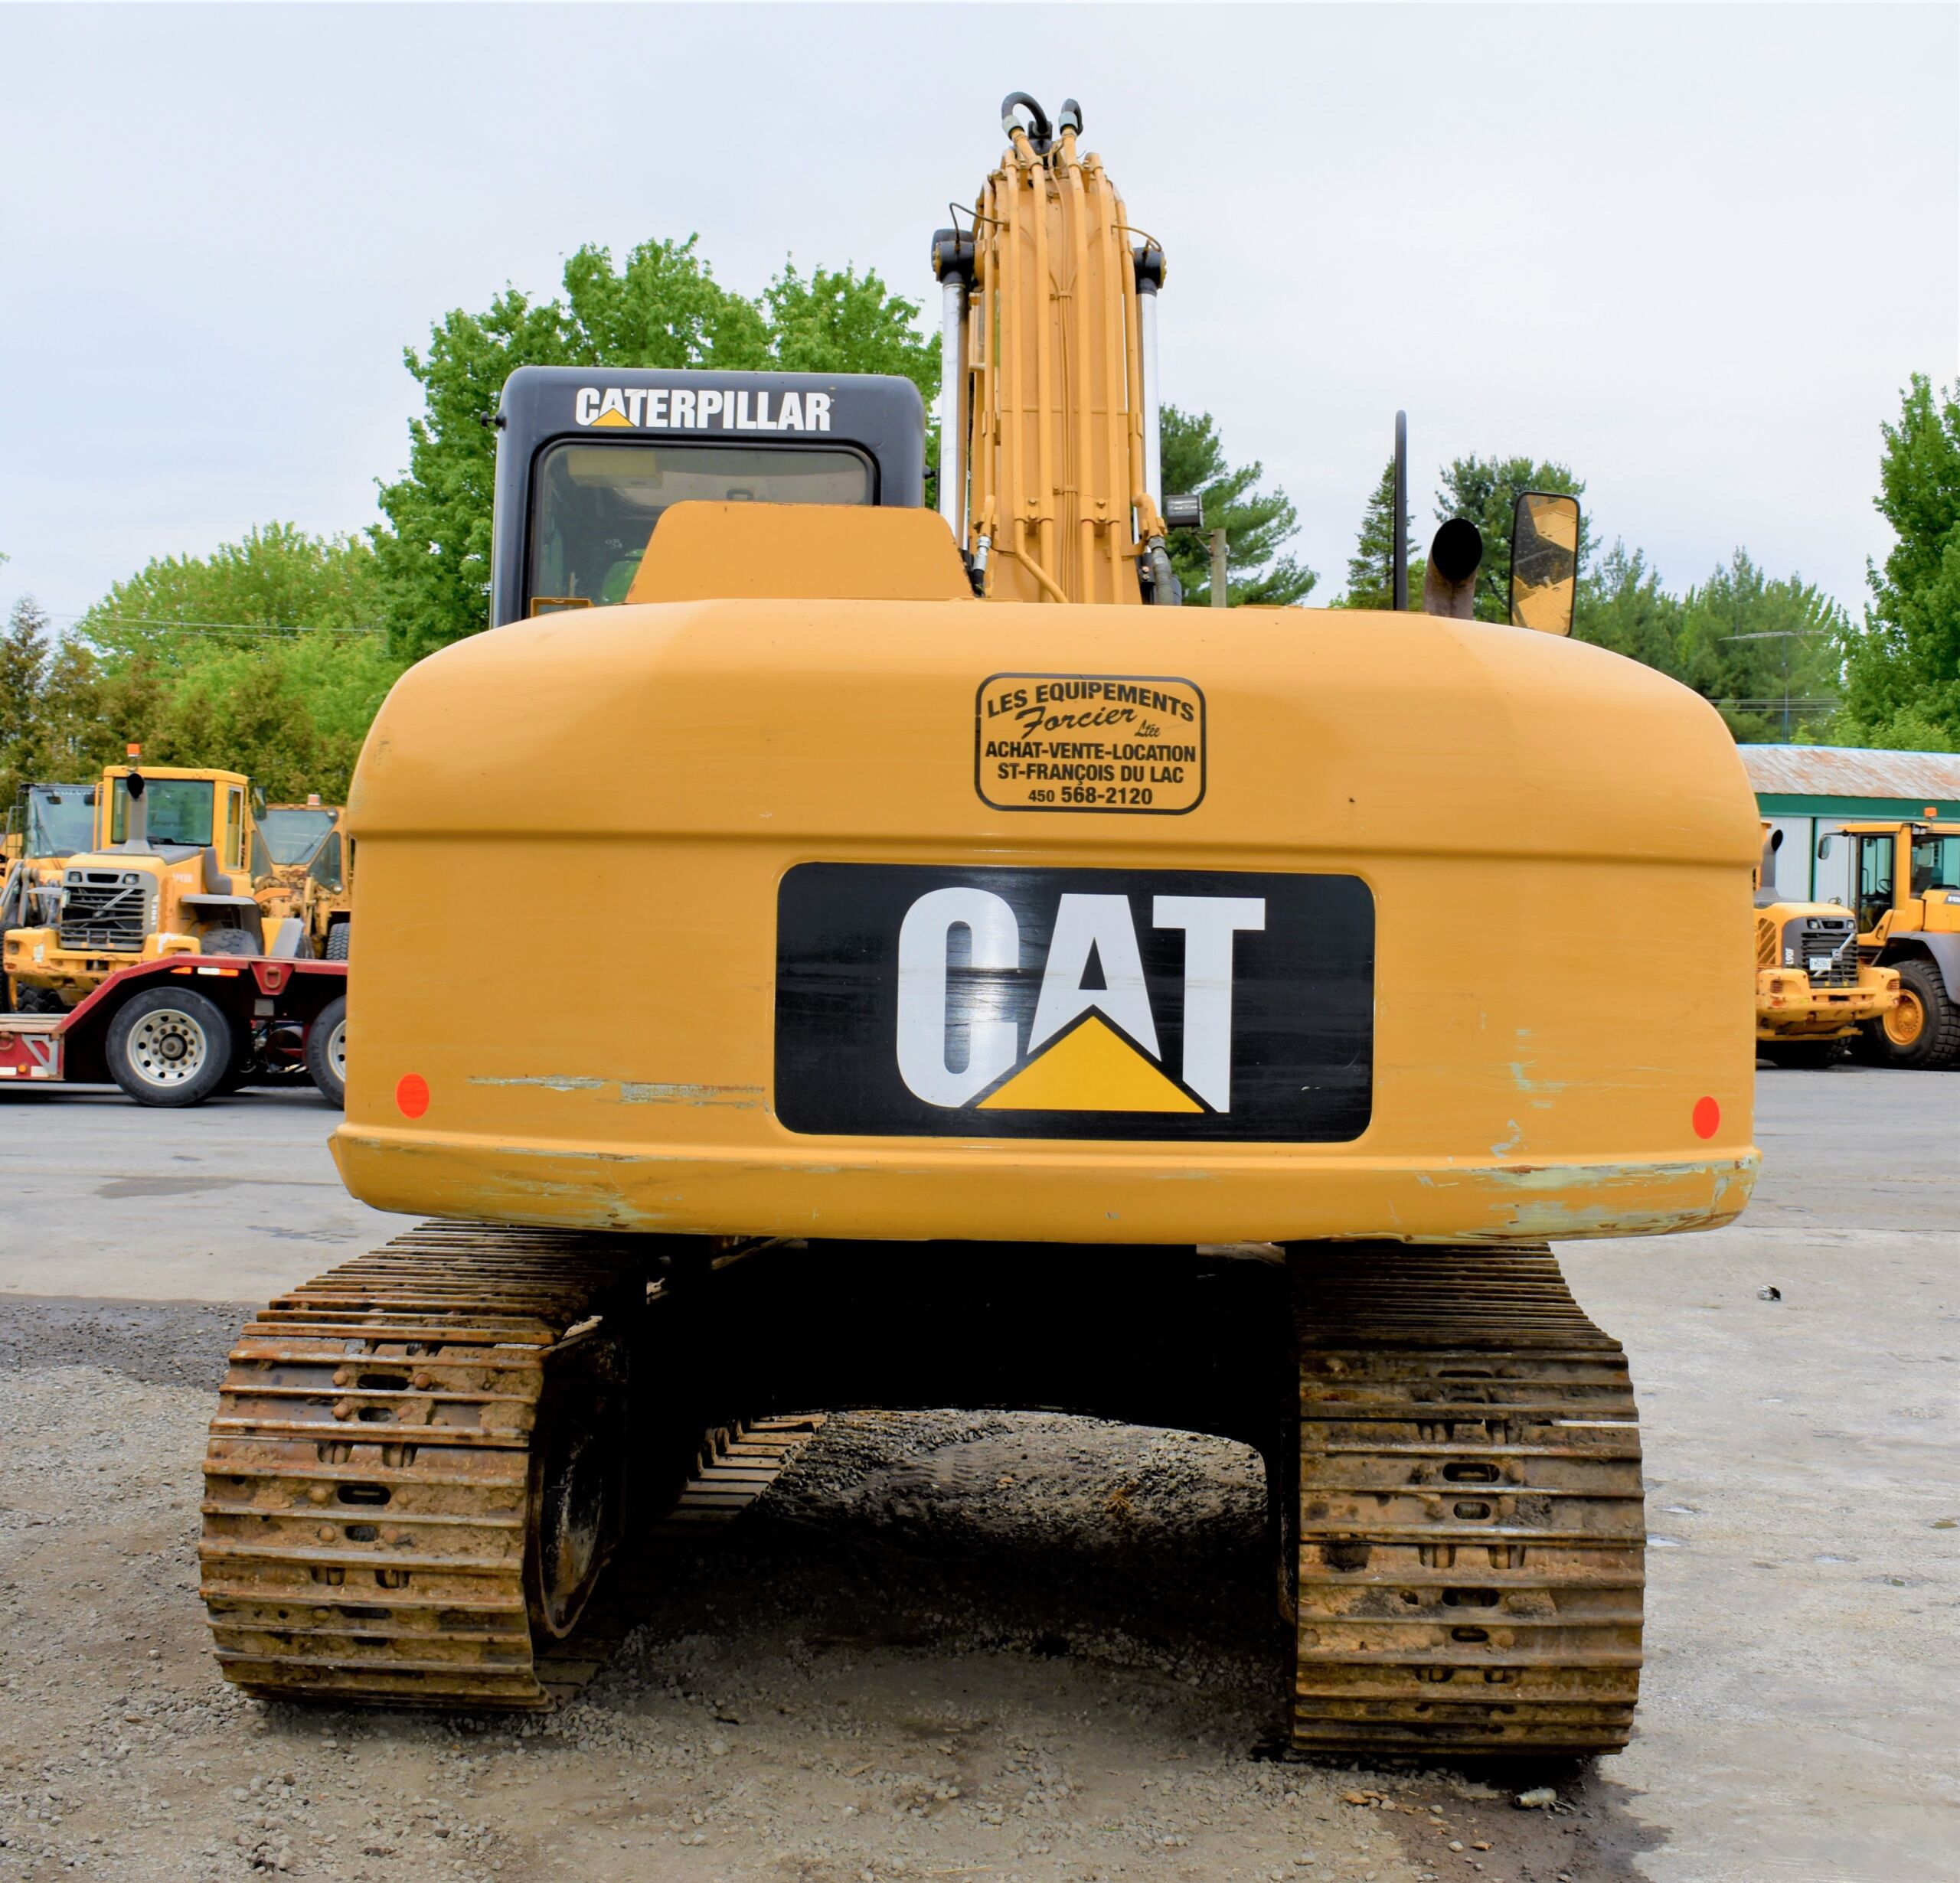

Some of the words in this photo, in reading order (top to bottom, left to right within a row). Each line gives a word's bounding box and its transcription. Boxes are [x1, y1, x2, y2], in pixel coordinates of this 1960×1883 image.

[575, 387, 831, 431] CATERPILLAR
[987, 689, 1027, 718] LES
[1036, 681, 1194, 722] EQUIPEMENTS
[1014, 706, 1138, 739] Forcier
[985, 741, 1196, 762] ACHAT-VENTE-LOCATION
[998, 762, 1115, 785] ST-FRANÇOIS
[1120, 766, 1145, 782] DU
[1150, 766, 1184, 783] LAC
[1028, 789, 1055, 802] 450
[1061, 786, 1152, 804] 568-2120
[897, 887, 1266, 1113] CAT
